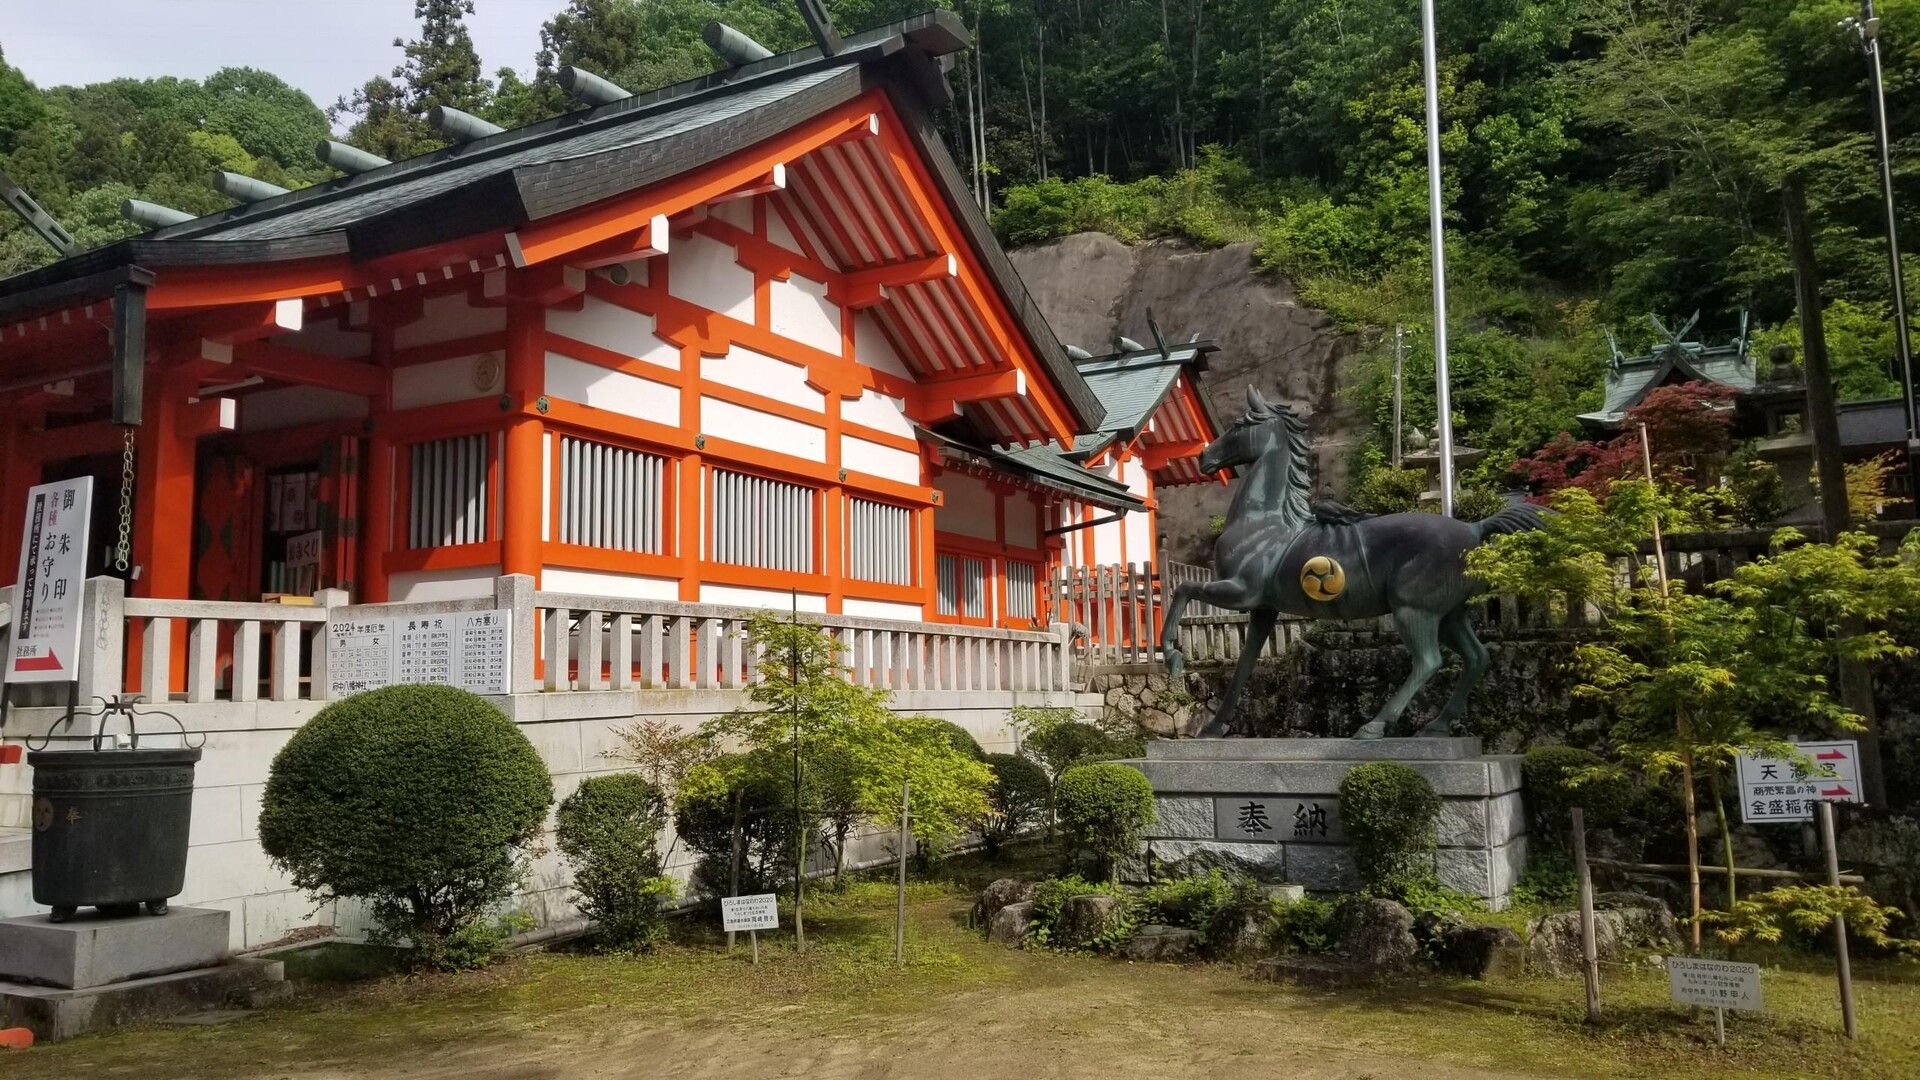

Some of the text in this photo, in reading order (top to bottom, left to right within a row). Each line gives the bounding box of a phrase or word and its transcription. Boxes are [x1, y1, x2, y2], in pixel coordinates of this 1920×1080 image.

[53, 488, 76, 601] 御朱印
[339, 637, 380, 648] 男 女
[16, 645, 38, 658] 社務所
[1753, 785, 1817, 796] 商売繁昌の神
[1236, 800, 1329, 838] 奉納
[1672, 960, 1755, 974] ひろしまはなのわ2020
